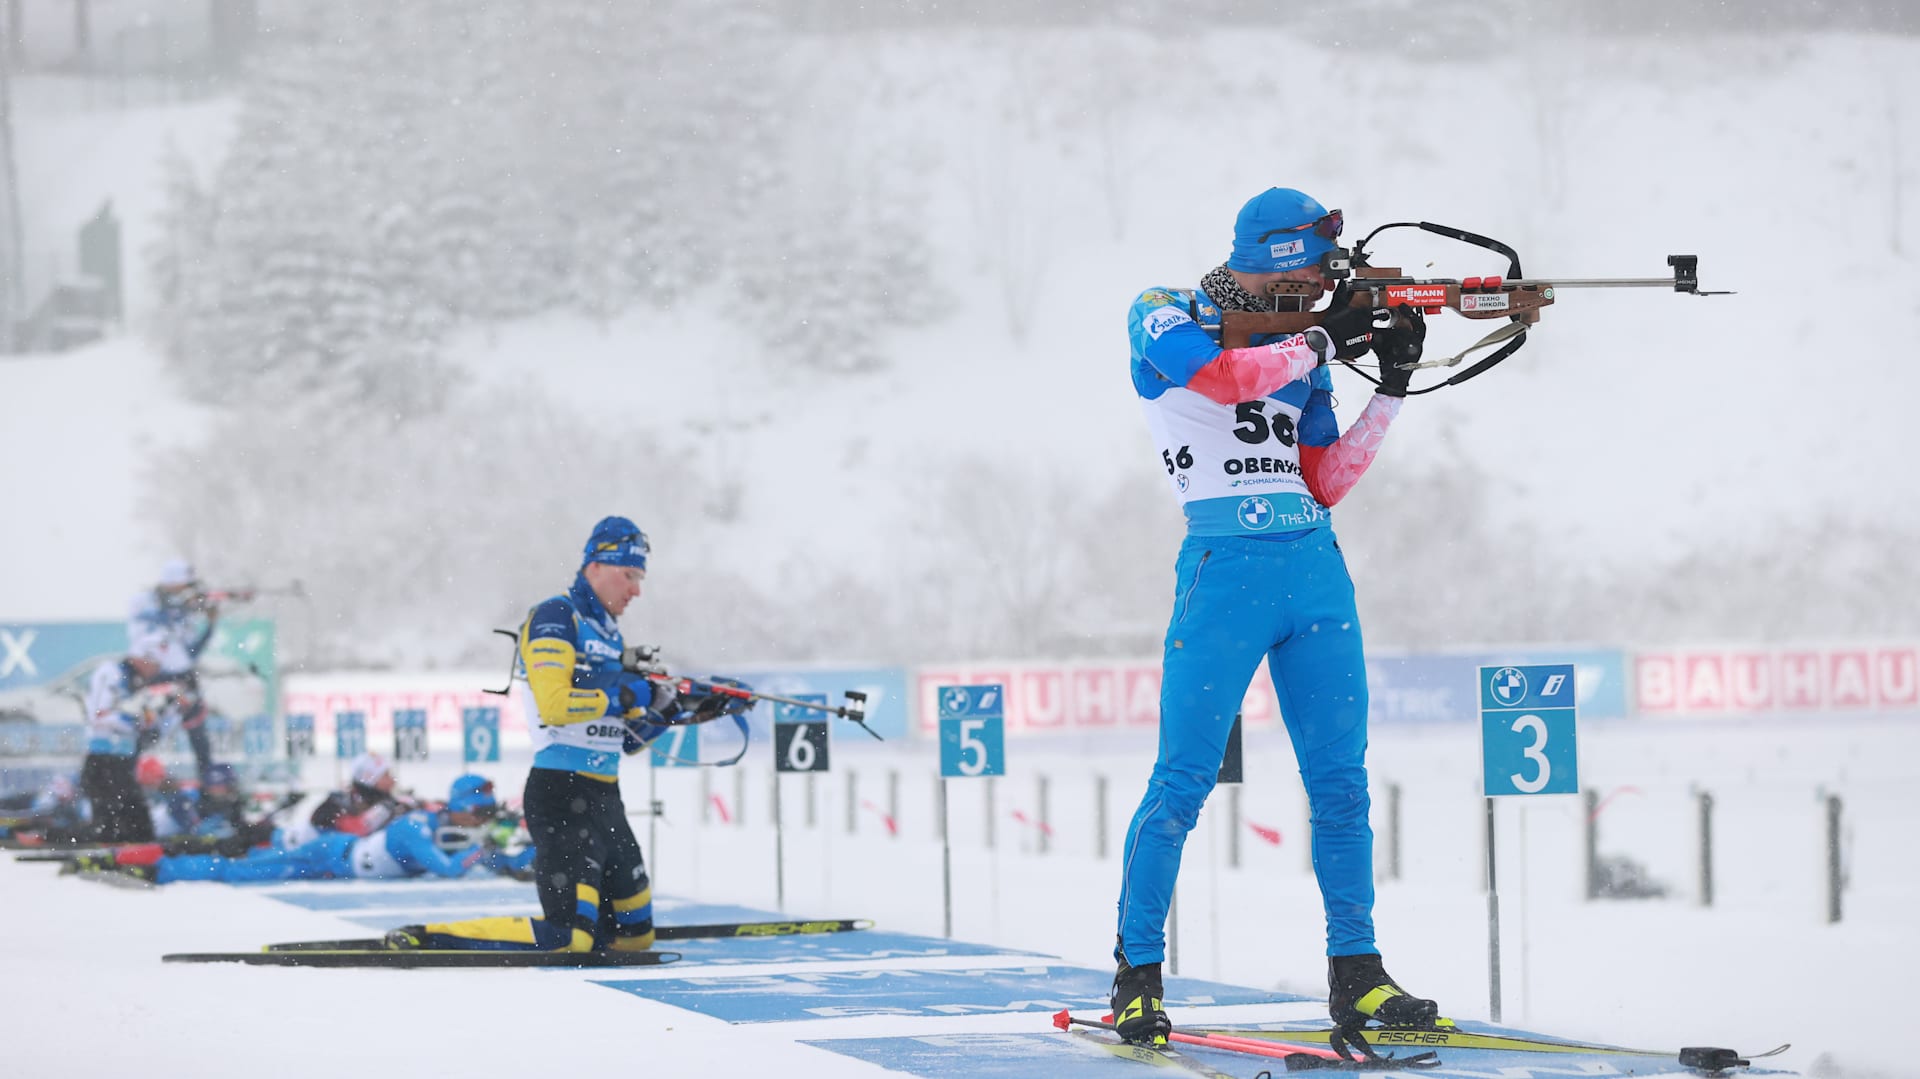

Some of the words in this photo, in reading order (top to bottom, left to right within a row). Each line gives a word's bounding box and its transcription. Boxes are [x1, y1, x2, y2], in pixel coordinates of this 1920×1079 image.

[1389, 288, 1444, 301] VIESSMANN
[1162, 445, 1194, 475] 56
[1278, 513, 1305, 526] THE
[471, 726, 492, 762] 9
[665, 724, 686, 767] 7
[788, 724, 815, 768] 6
[958, 720, 987, 776] 5
[1510, 714, 1551, 793] 3
[1377, 1031, 1449, 1044] FISCHER
